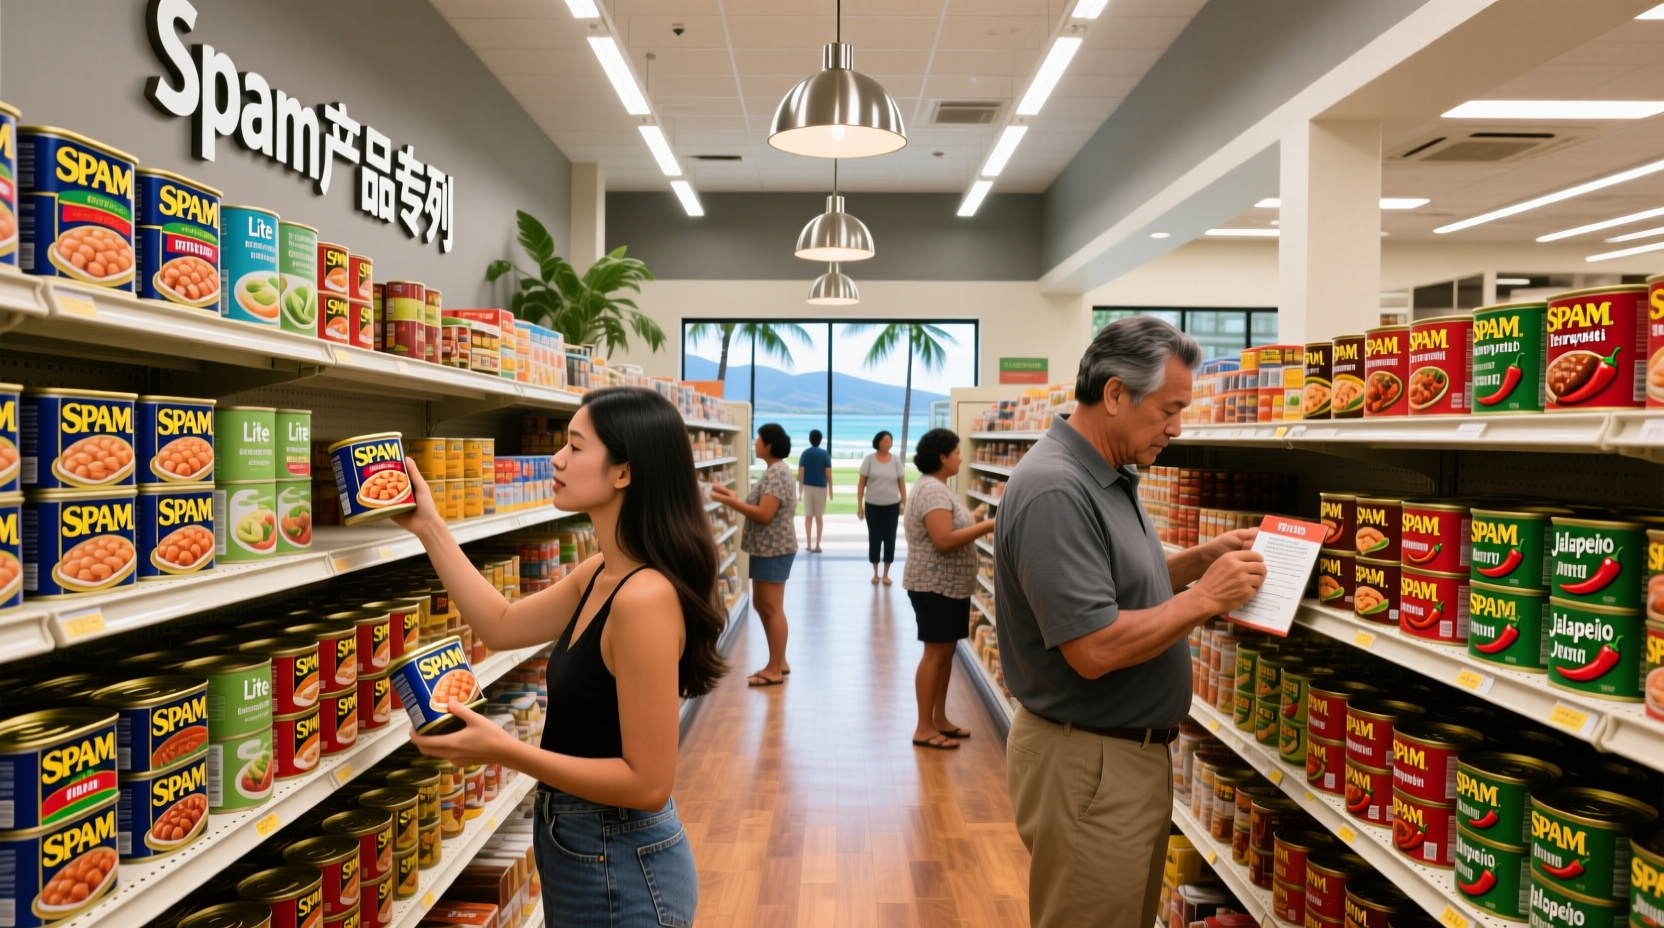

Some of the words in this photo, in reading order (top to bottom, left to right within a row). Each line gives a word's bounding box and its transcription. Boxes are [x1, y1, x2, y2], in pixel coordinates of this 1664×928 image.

[56, 146, 132, 199] SPAM
[159, 184, 218, 228] SPAM
[249, 216, 272, 240] Lite
[62, 403, 133, 434] SPAM
[157, 409, 213, 435] SPAM
[243, 421, 270, 443] Lite
[354, 442, 402, 467] SPAM
[62, 503, 133, 537] SPAM
[158, 497, 213, 526] SPAM
[1471, 520, 1518, 546] SPAM
[419, 646, 466, 680] SPAM
[244, 677, 269, 700] Lite
[152, 695, 208, 737] SPAM
[42, 732, 116, 784] SPAM
[153, 762, 207, 807] SPAM
[42, 810, 117, 868] SPAM
